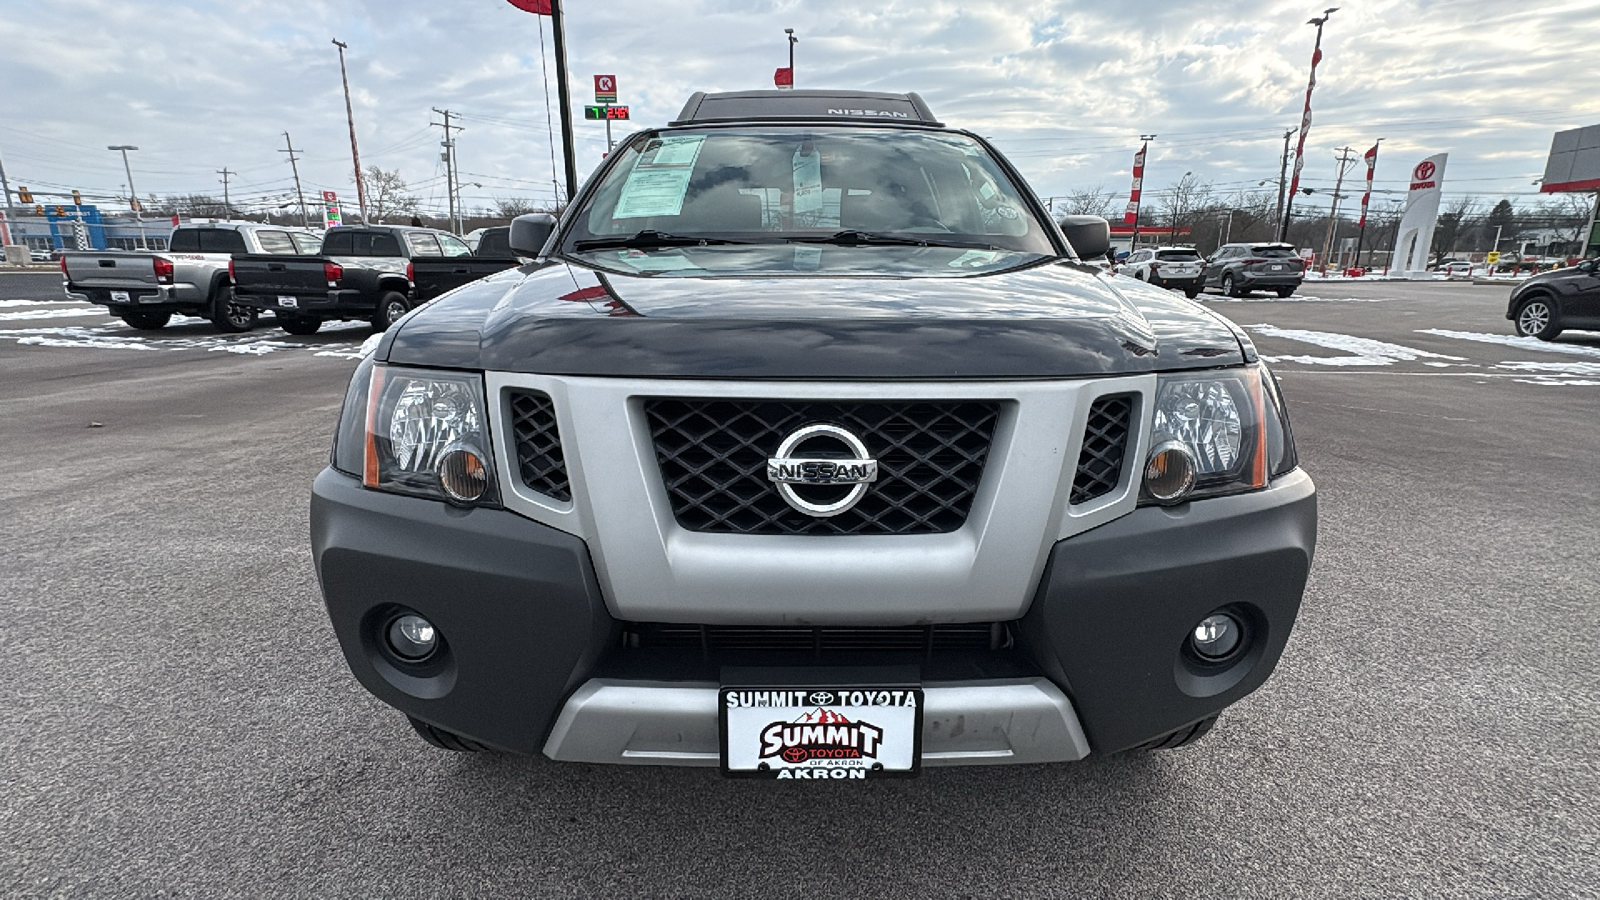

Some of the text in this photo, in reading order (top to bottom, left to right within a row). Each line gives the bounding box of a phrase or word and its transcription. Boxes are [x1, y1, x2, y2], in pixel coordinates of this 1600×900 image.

[827, 108, 908, 118] NISSAN
[778, 464, 868, 479] NISSAN
[726, 691, 917, 708] SUMMIT TOYOTA
[762, 723, 880, 757] SUMMIT
[809, 749, 860, 758] TOYOTA
[776, 769, 867, 780] AKRON
